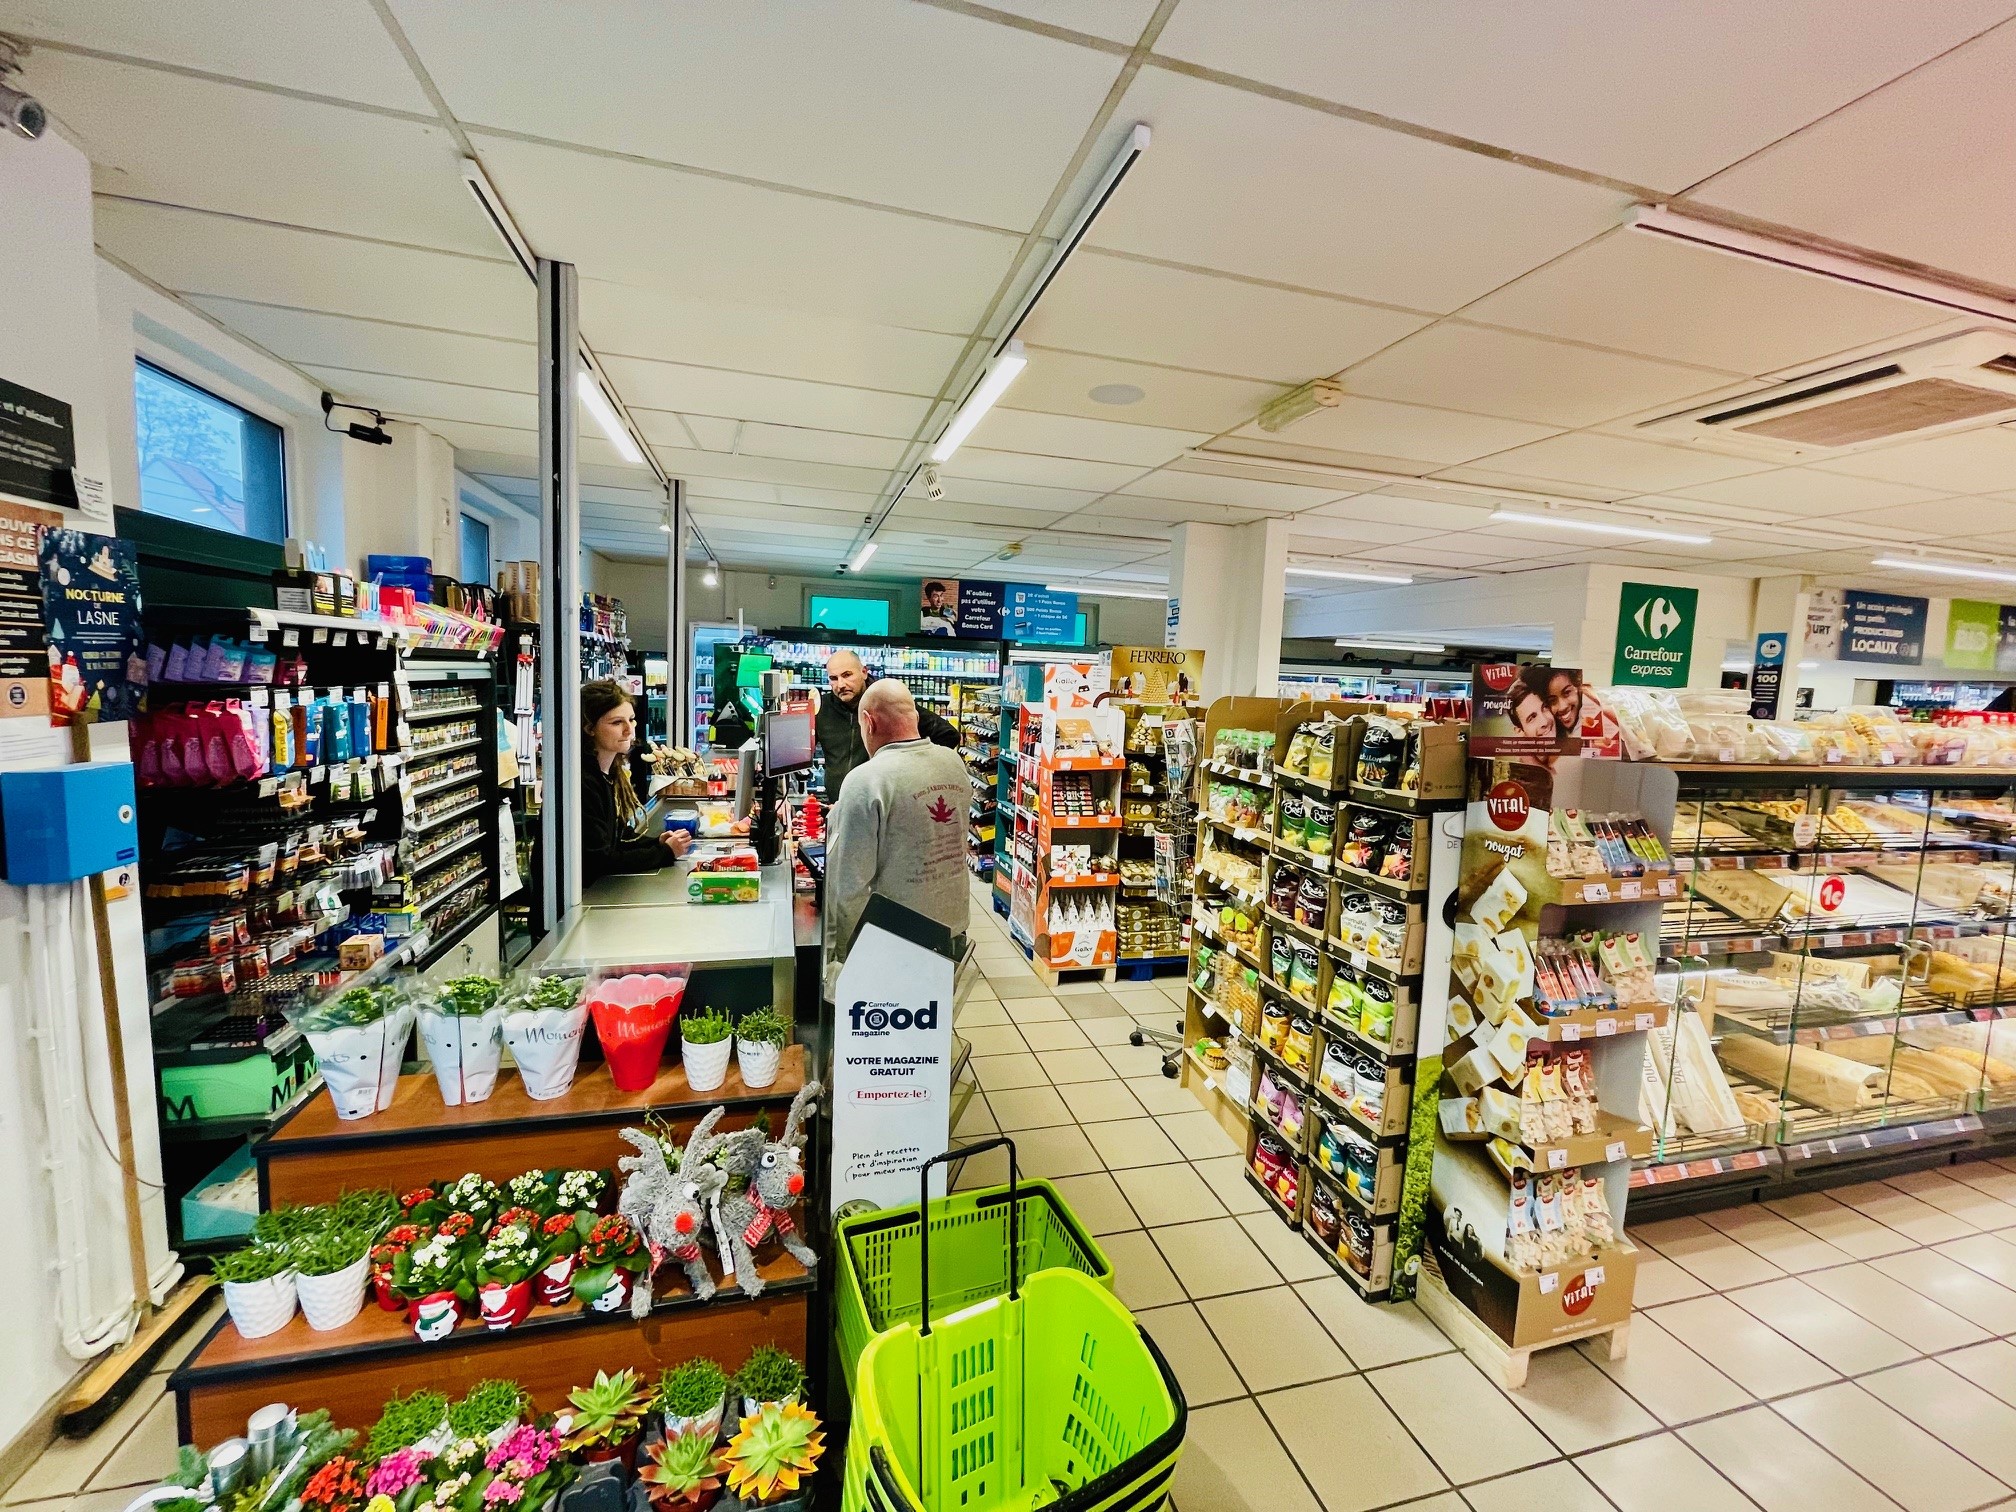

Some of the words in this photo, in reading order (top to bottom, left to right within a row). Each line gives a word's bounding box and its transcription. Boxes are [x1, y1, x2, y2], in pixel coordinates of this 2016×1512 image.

[17, 536, 36, 549] CE
[65, 588, 126, 604] NOCTURNE
[77, 610, 120, 626] LASNE
[964, 614, 991, 622] Carrefour
[961, 622, 979, 630] Bonus
[1624, 645, 1683, 663] Carrefour
[1851, 639, 1899, 654] LOCAUX
[1129, 650, 1186, 665] FERRERO
[1630, 663, 1673, 677] express
[1756, 675, 1778, 683] 100
[1483, 698, 1513, 714] nougat
[1485, 839, 1525, 862] nougat
[848, 1000, 938, 1030] food
[851, 1030, 890, 1038] magazine
[846, 1056, 882, 1066] VOTRE
[883, 1056, 939, 1065] MAGAZINE
[869, 1067, 916, 1076] GRATUIT
[856, 1090, 922, 1100] Emportez-le
[923, 1089, 927, 1098] !
[852, 1151, 870, 1161] Plein
[873, 1149, 884, 1158] de
[886, 1145, 920, 1156] recettes
[857, 1161, 867, 1170] et
[869, 1155, 918, 1168] d'inspiration
[852, 1170, 870, 1181] pour
[873, 1167, 896, 1176] mieux
[898, 1162, 927, 1175] mange
[1460, 1263, 1484, 1287] BELGIUM
